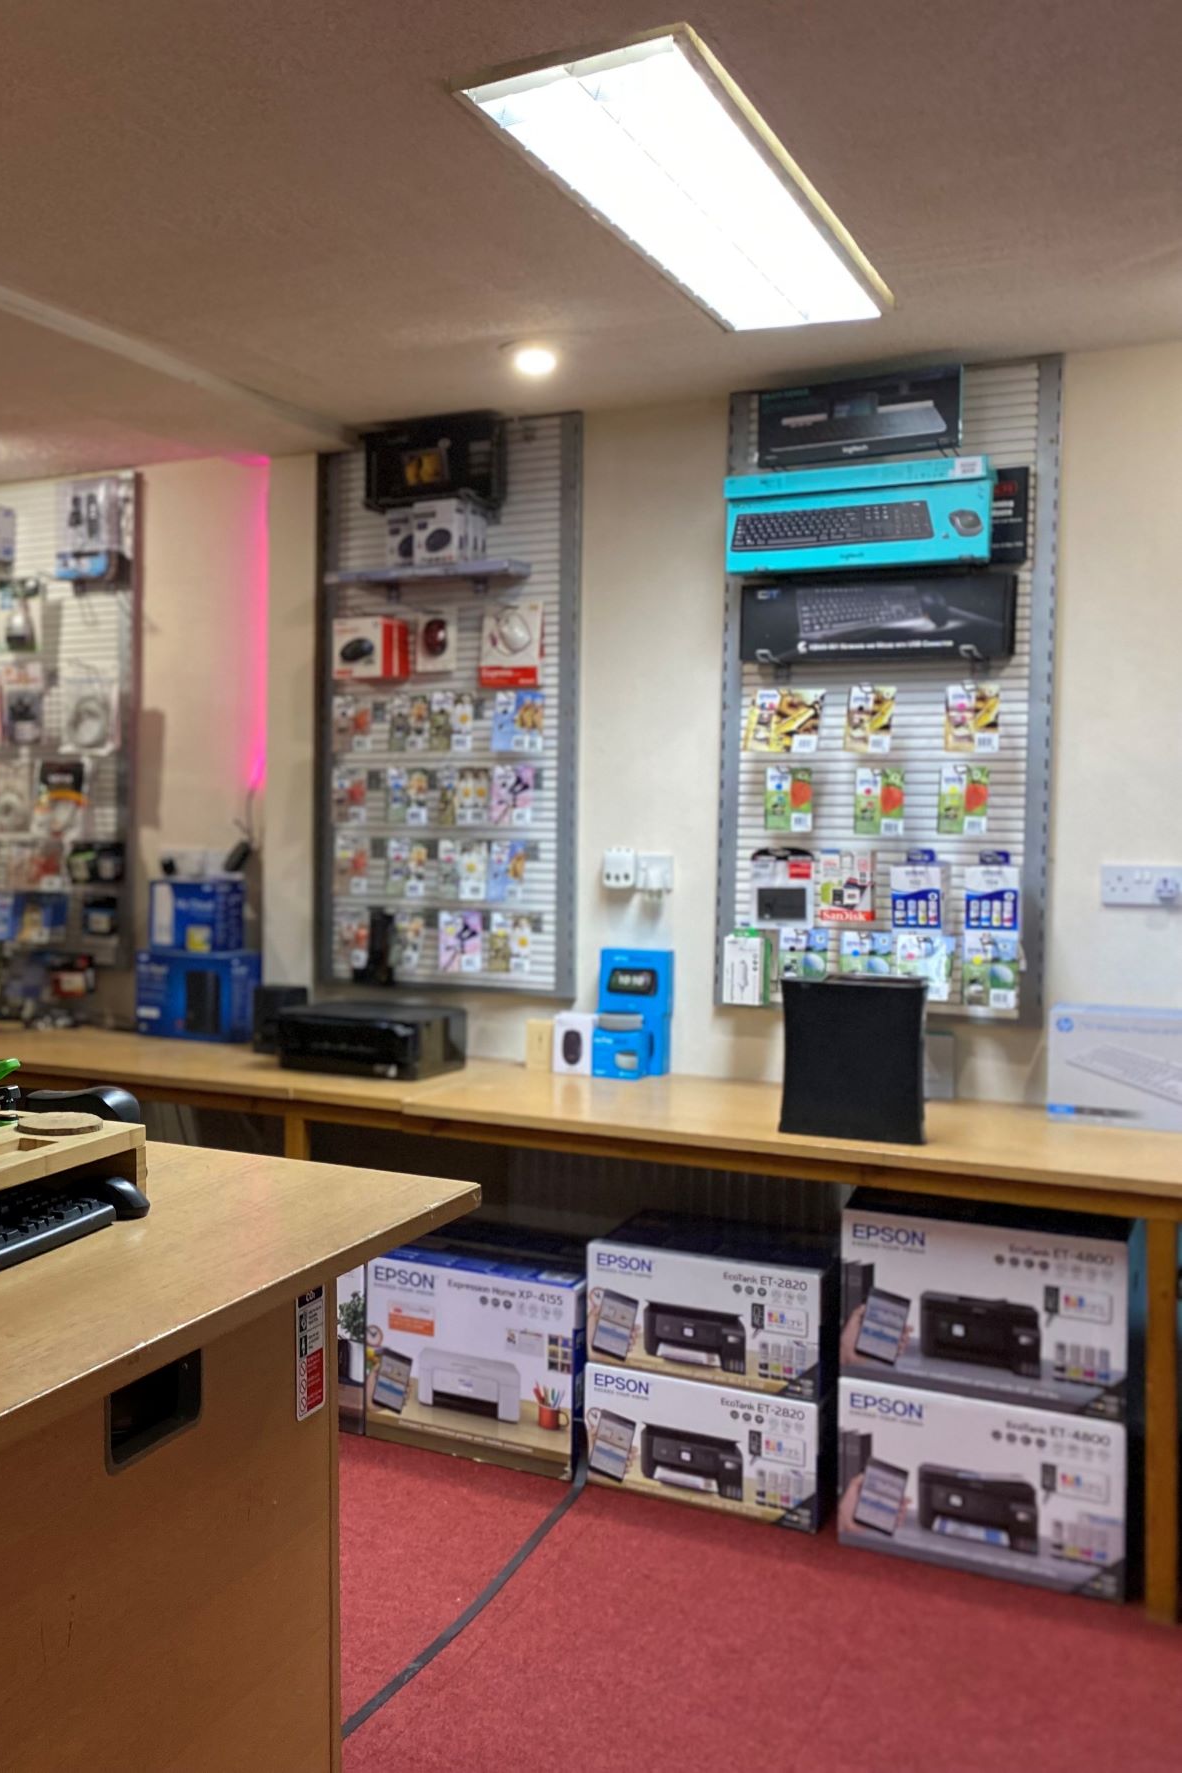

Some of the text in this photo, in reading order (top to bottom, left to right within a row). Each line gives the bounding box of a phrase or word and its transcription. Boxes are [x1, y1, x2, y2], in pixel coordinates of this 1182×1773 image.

[822, 911, 866, 921] SanDisk
[852, 1223, 926, 1247] EPSON
[596, 1252, 652, 1273] EPSON
[1052, 1247, 1114, 1266] ET-4800
[374, 1265, 435, 1290] EPSON
[723, 1272, 808, 1292] EcoTank ET-2820
[447, 1279, 491, 1294] Expression
[492, 1286, 517, 1298] Home
[517, 1289, 564, 1306] XP-4155
[593, 1373, 650, 1395] EPSON
[720, 1398, 806, 1421] EcoTank ET-2820
[849, 1392, 923, 1419] EPSON
[1050, 1426, 1111, 1447] ET-4800
